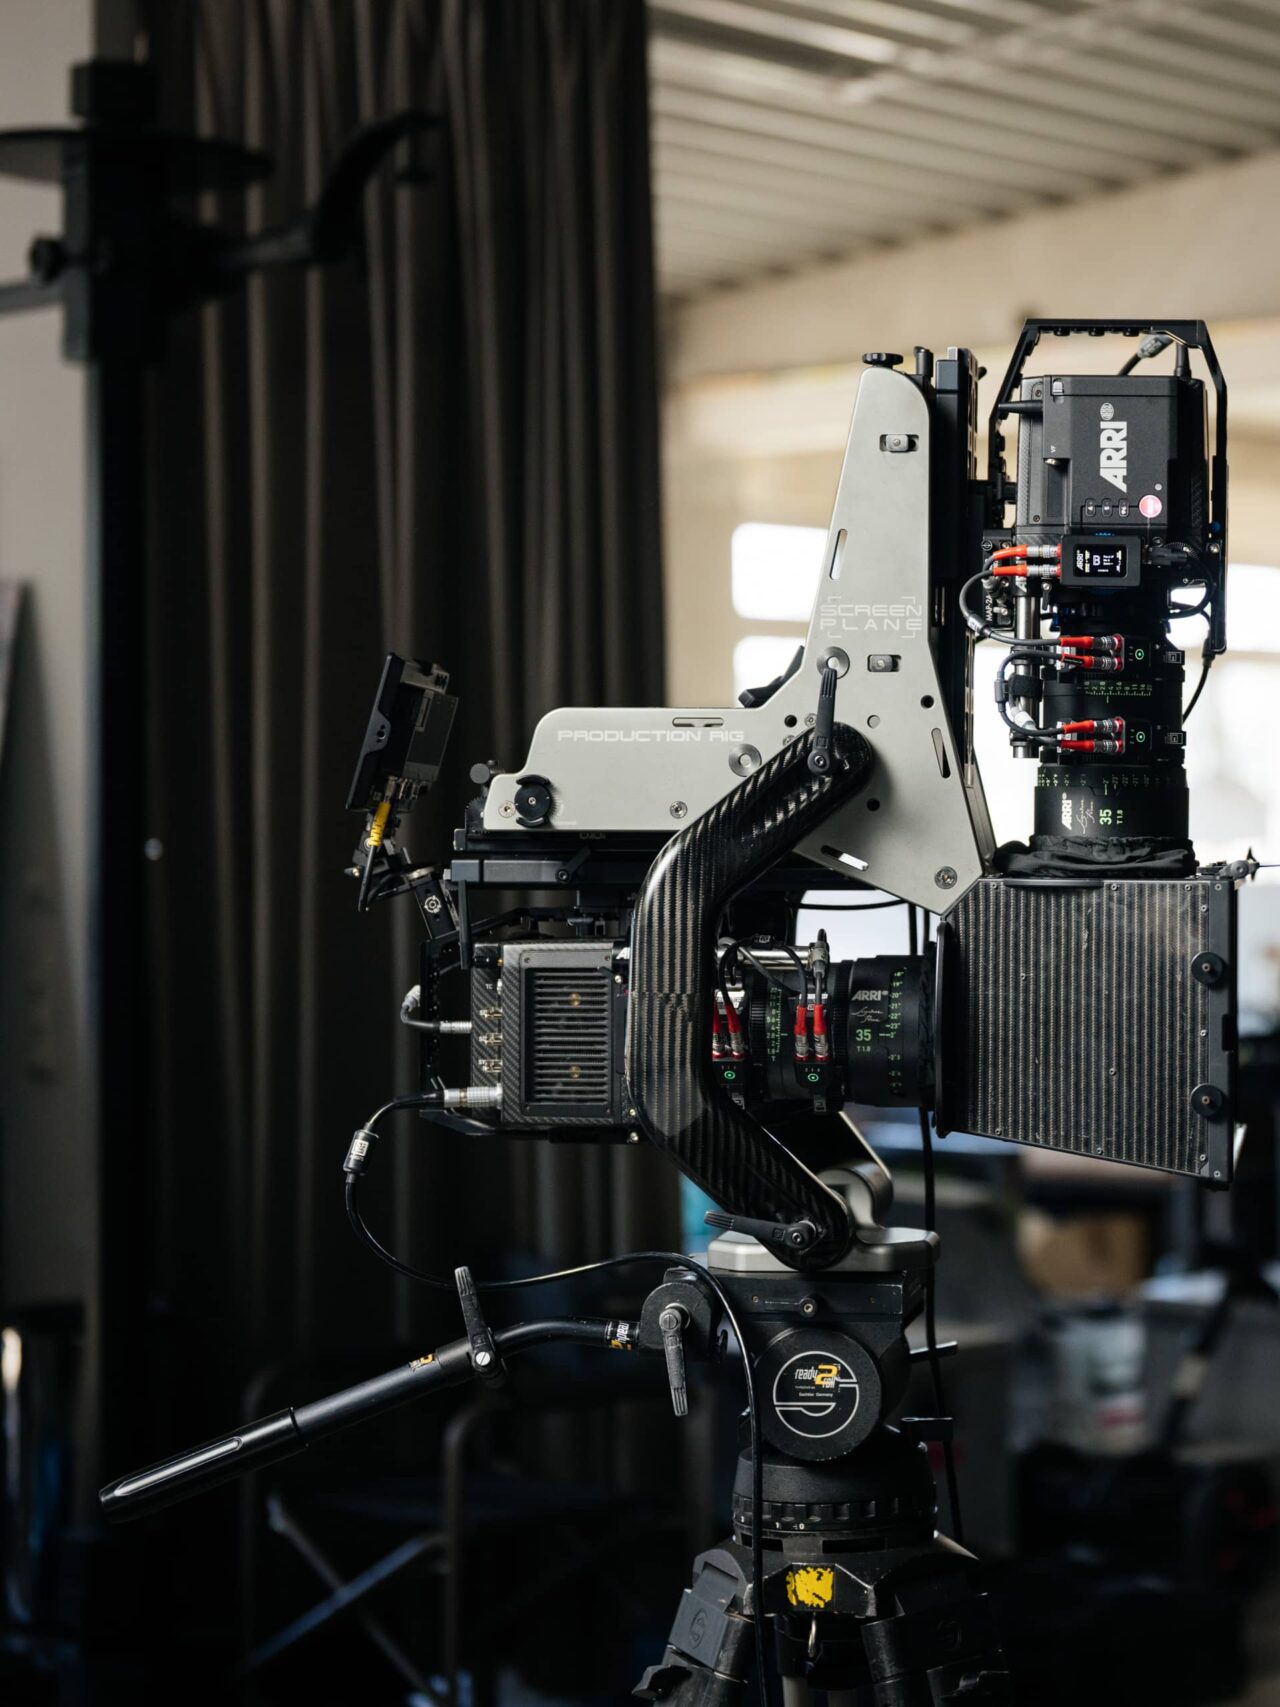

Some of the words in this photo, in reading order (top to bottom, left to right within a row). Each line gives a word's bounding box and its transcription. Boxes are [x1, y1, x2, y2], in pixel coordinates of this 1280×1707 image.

[1100, 421, 1127, 493] ARRI
[1076, 553, 1084, 571] ARRI
[1092, 555, 1101, 566] B
[819, 604, 922, 617] SCREEN
[985, 595, 993, 622] MAP-2A
[819, 618, 922, 631] PLANE
[557, 730, 701, 742] PRODUCTION
[709, 730, 744, 742] RIG
[1061, 800, 1072, 830] ARRI
[1099, 809, 1112, 825] 35
[851, 990, 881, 1001] ARRI
[855, 1028, 871, 1042] 35
[794, 1366, 818, 1382] ready
